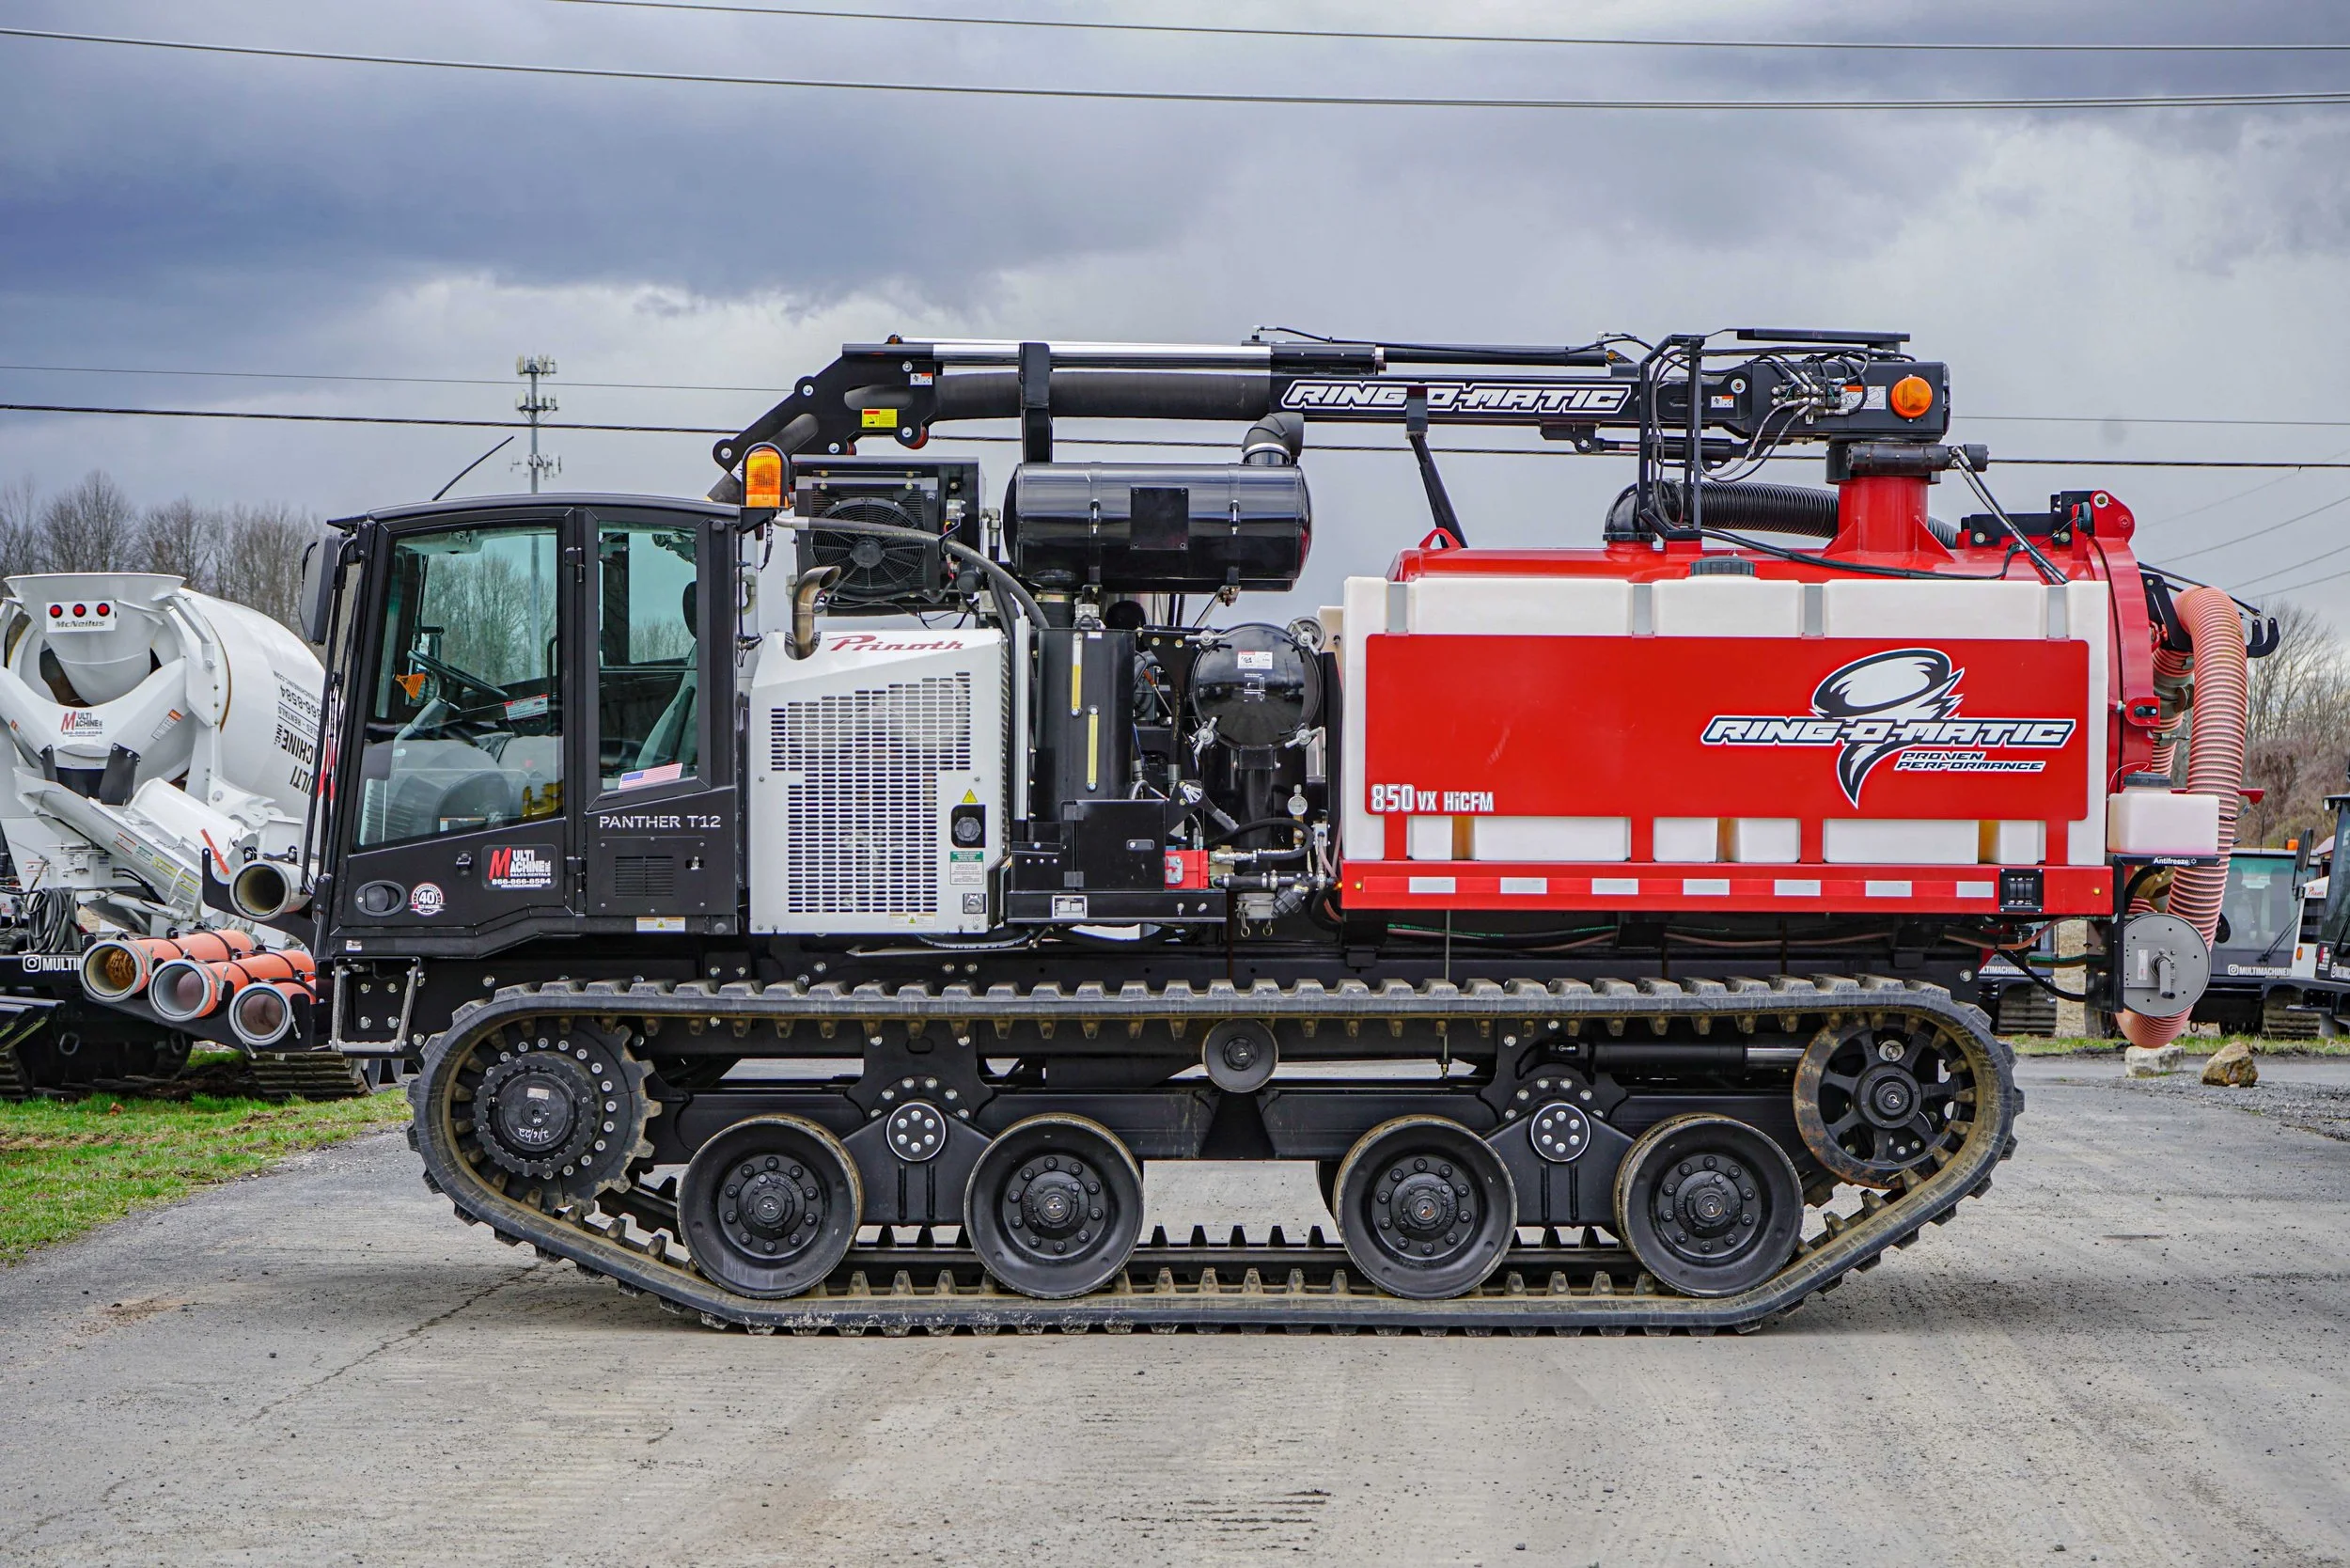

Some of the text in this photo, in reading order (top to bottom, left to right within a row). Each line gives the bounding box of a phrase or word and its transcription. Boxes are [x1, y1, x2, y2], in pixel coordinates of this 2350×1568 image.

[1285, 384, 1626, 409] RINGO-MATIC
[54, 619, 105, 628] McNeilus
[827, 635, 964, 651] Prinoth
[278, 706, 302, 727] RENTALS
[1703, 718, 2074, 745] RING-O-MATIC
[281, 729, 317, 765] CHINE
[1900, 751, 1984, 760] PROVEN
[1896, 761, 2044, 771] PERFORMANCE
[290, 765, 314, 796] ULTI
[1371, 784, 1495, 812] 850 VX HiCFM
[599, 815, 721, 828] PANTHER T12
[418, 891, 435, 904] 40
[517, 1127, 550, 1143] 2/16/22
